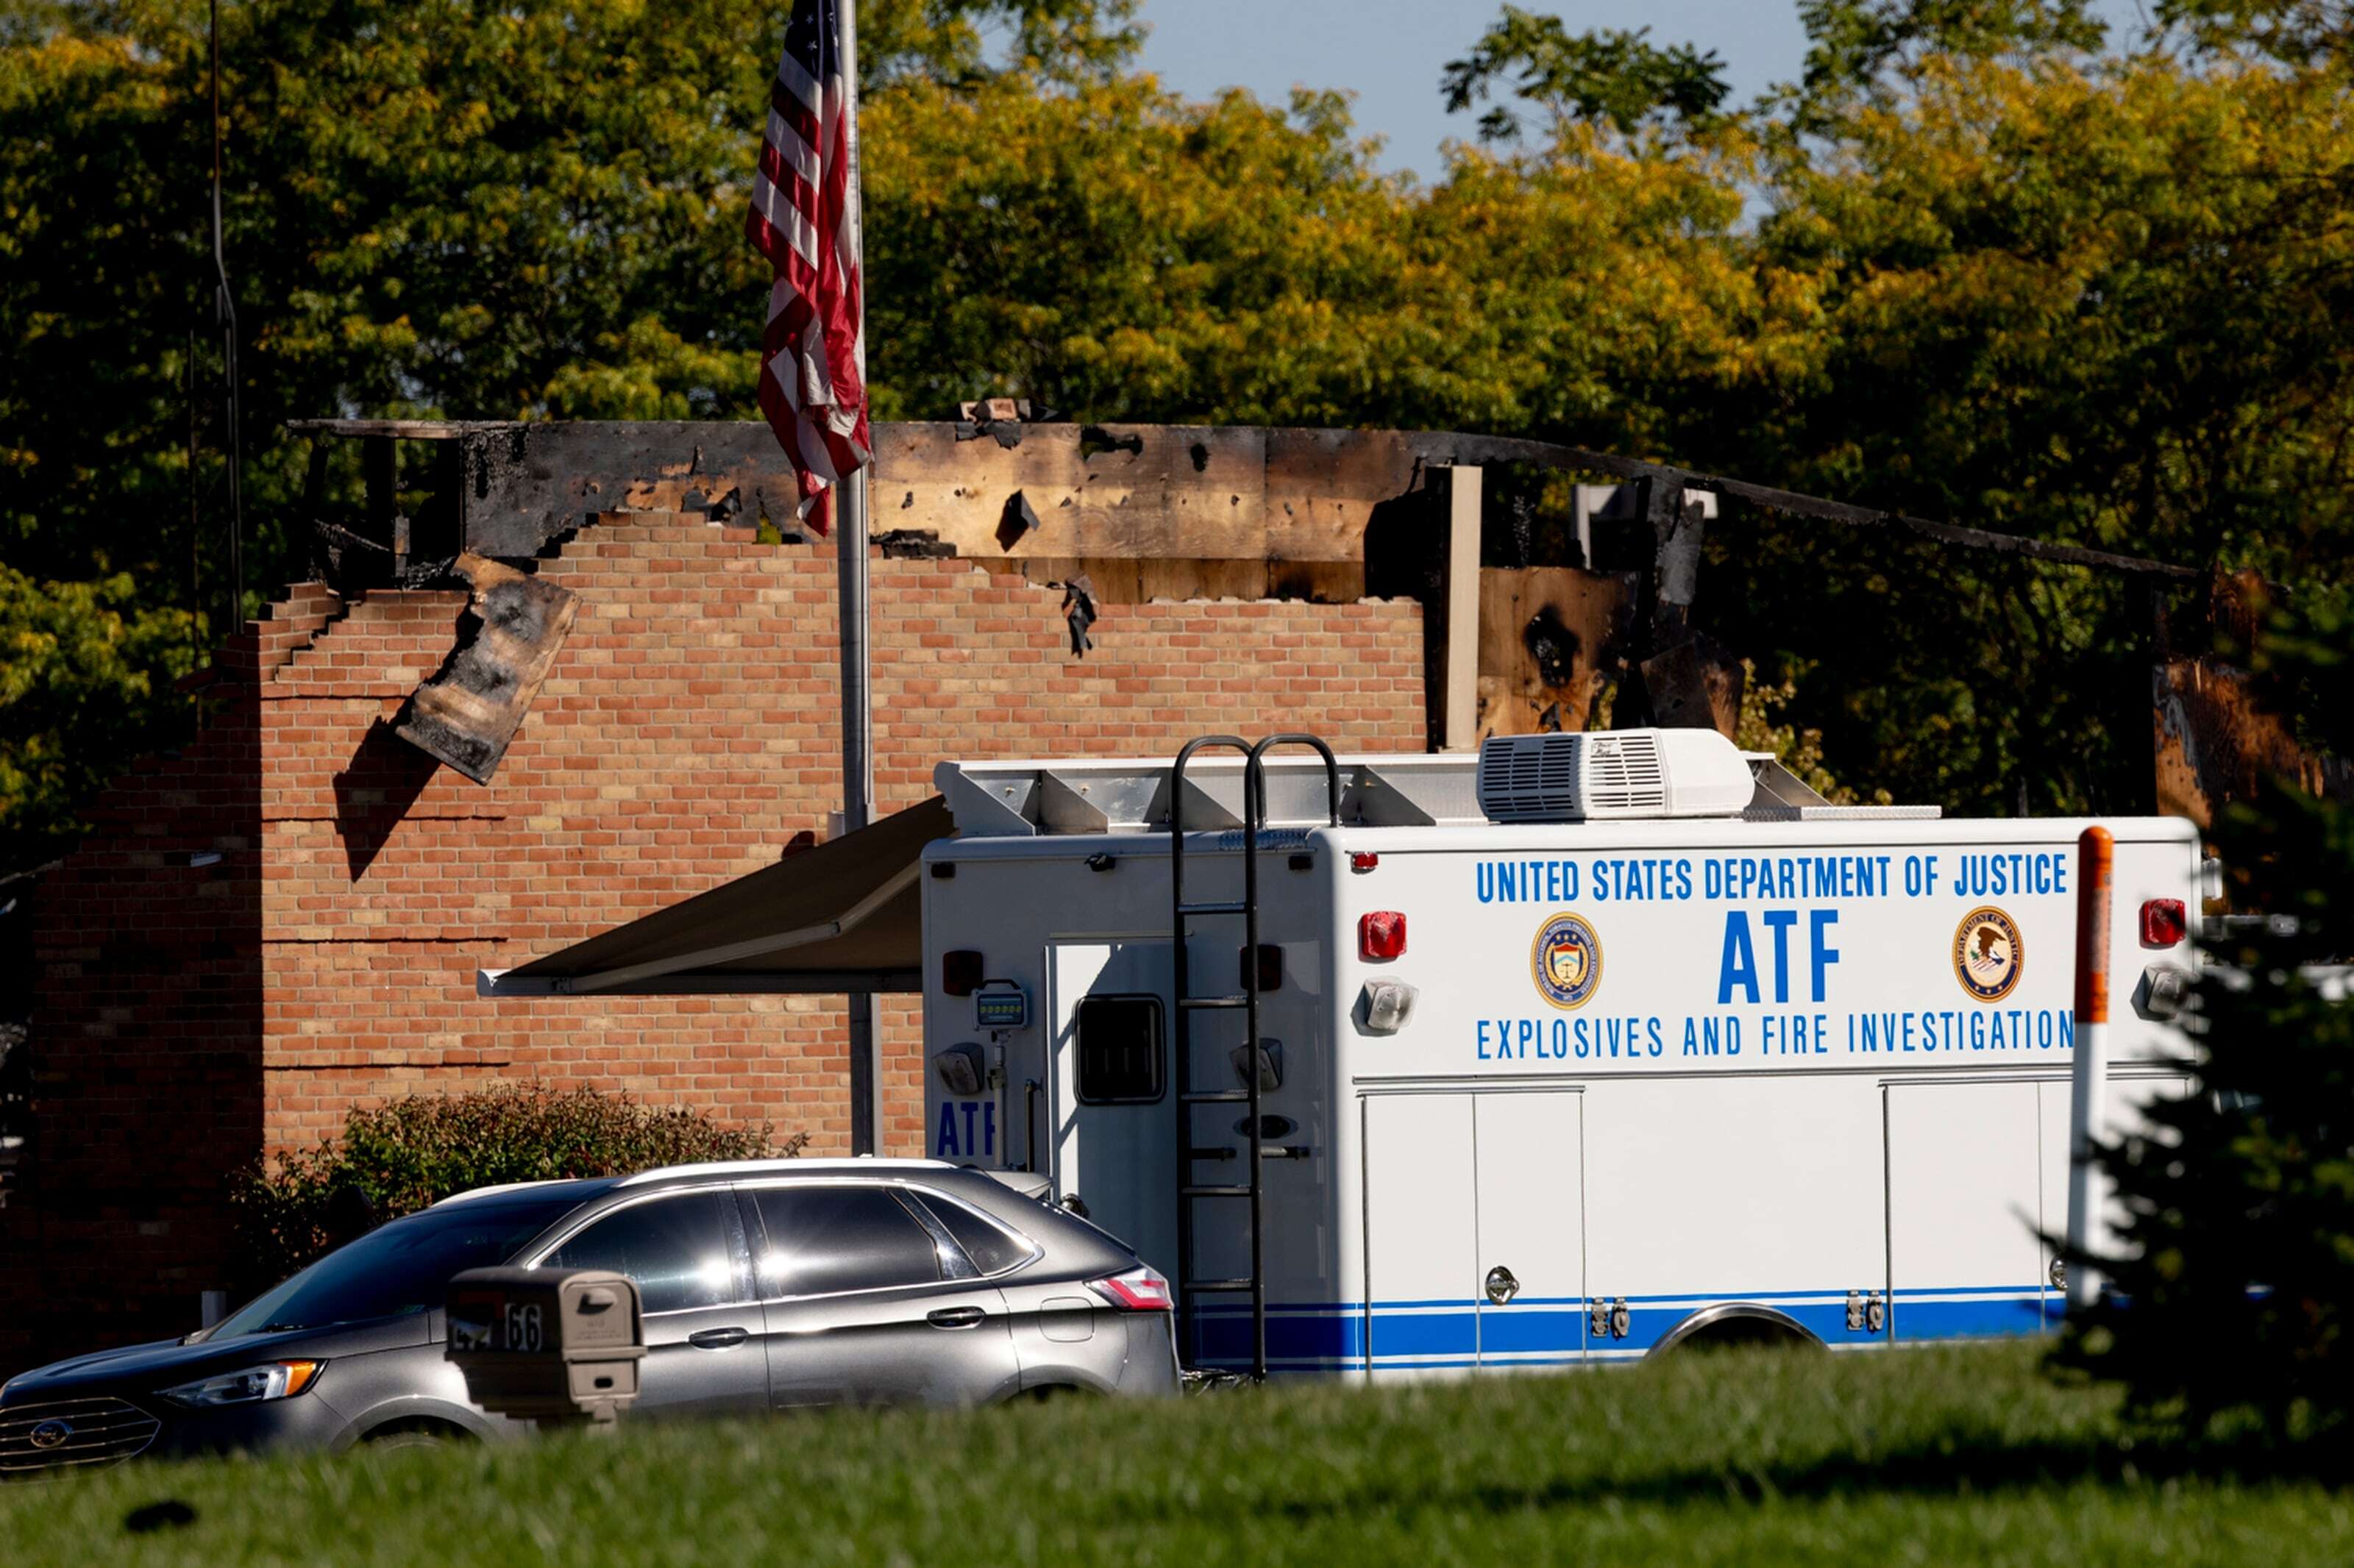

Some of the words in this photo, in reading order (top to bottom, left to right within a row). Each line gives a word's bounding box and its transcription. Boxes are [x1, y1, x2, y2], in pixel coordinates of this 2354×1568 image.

[1476, 860, 1579, 904] UNITED
[1591, 859, 1693, 902] STATES
[1704, 856, 1891, 900] DEPARTMENT
[1904, 855, 1938, 897] OF
[1954, 853, 2067, 897] JUSTICE
[1717, 908, 1840, 1005] ATF
[1477, 1016, 1663, 1060] EXPLOSIVES
[1682, 1016, 1741, 1056] AND
[1762, 1014, 1828, 1055] FIRE
[1848, 1009, 2074, 1053] INVESTIGATION
